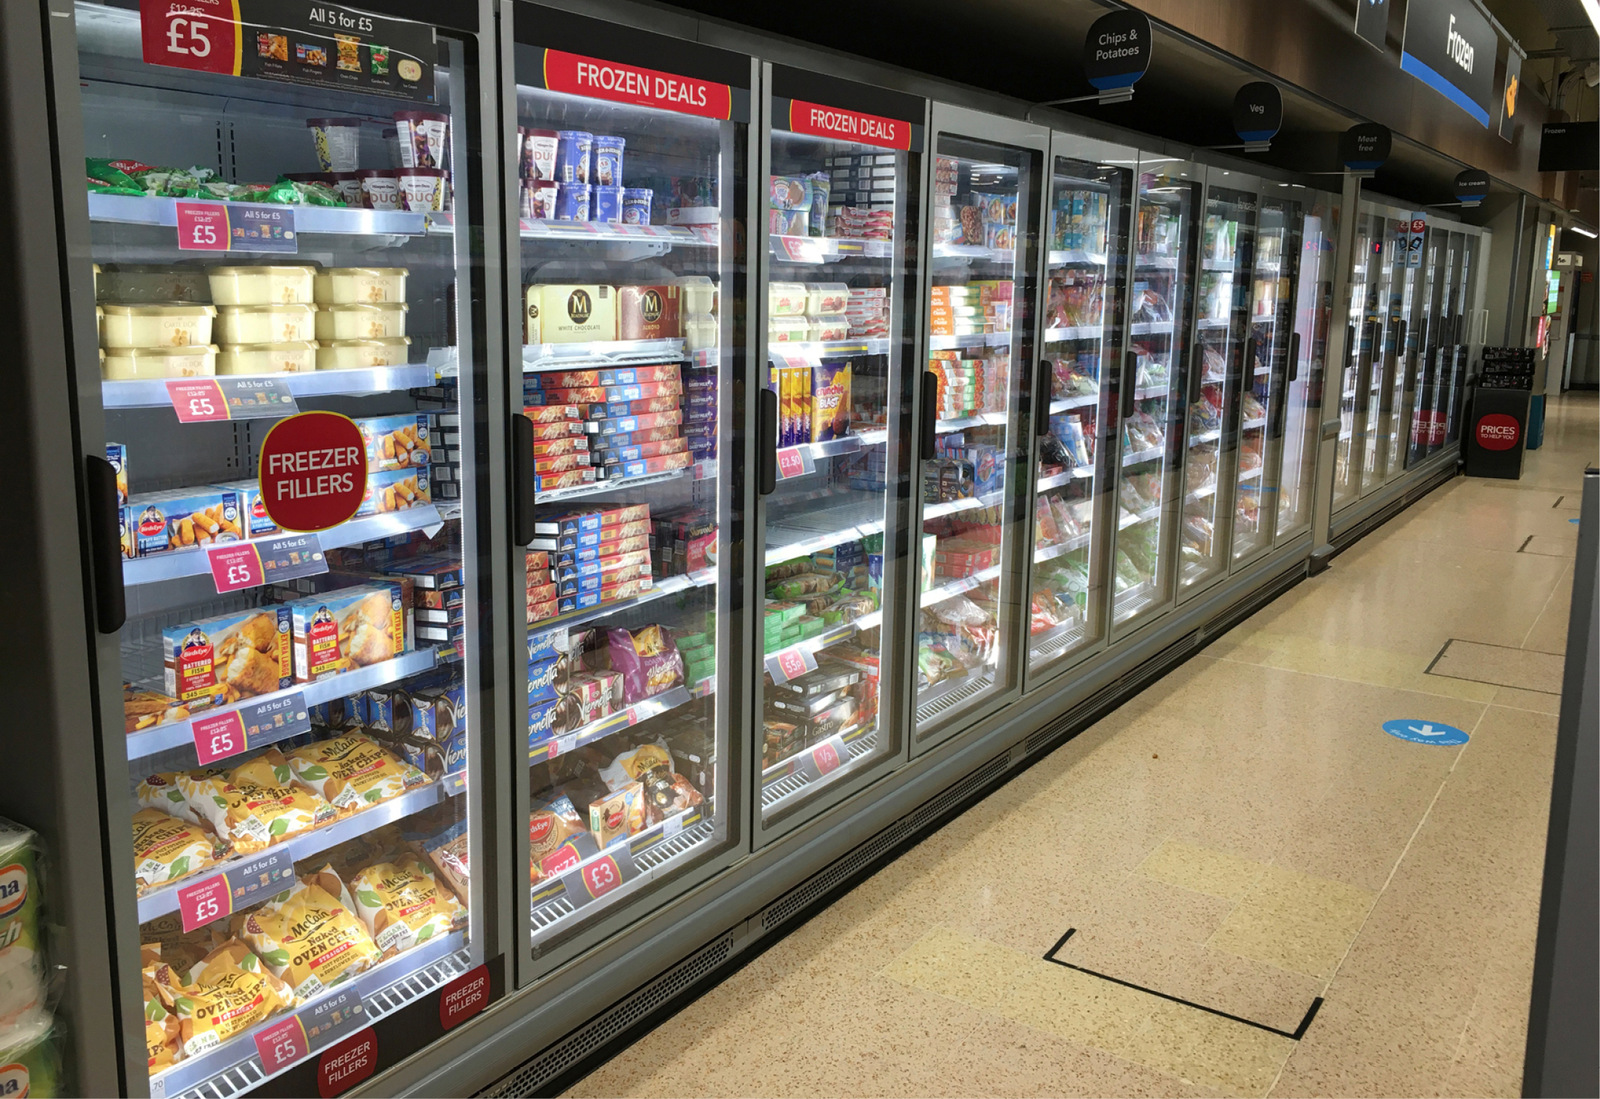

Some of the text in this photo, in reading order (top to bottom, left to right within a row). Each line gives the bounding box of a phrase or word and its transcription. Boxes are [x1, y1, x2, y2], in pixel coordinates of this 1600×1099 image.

[309, 8, 373, 32] All 5 for £5
[167, 18, 211, 57] £5
[1098, 29, 1138, 46] Chips &
[1446, 14, 1475, 75] Frozen
[1095, 46, 1139, 61] Potatoes
[577, 62, 707, 106] FROZEN DEALS
[1250, 103, 1264, 114] Veg
[810, 108, 895, 140] FROZEN DEALS
[1358, 136, 1377, 144] Meat
[1358, 144, 1374, 152] free
[370, 193, 398, 204] DUO
[406, 192, 434, 202] DUO
[244, 211, 281, 220] All 5 for £5
[192, 224, 217, 244] £5
[237, 381, 246, 389] All
[253, 380, 264, 388] for
[265, 379, 274, 387] £5
[816, 384, 845, 396] crunchie
[189, 398, 215, 416] £5
[820, 396, 839, 409] BLAST
[1481, 425, 1515, 435] PRICES
[269, 446, 360, 475] FREEZER
[781, 455, 801, 468] £2.50
[277, 472, 354, 501] FILLERS
[272, 542, 281, 550] All
[287, 540, 297, 548] for
[298, 538, 306, 547] £5
[227, 565, 250, 584] £5
[312, 634, 337, 644] BATTERED
[183, 658, 212, 669] BATTERED
[281, 633, 289, 677] EXTRA LARGE
[785, 661, 802, 673] 55p
[186, 691, 198, 699] 345
[576, 686, 613, 720] Viennetta
[257, 706, 266, 715] All
[272, 701, 282, 710] for
[283, 699, 292, 707] £5
[812, 721, 834, 736] Gastro
[210, 733, 233, 755] £5
[321, 735, 358, 758] McCain
[356, 749, 388, 768] CHIPS
[529, 821, 548, 833] dsEye
[243, 857, 278, 876] All 5 for £5
[591, 863, 614, 890] £3
[195, 897, 219, 922] £5
[291, 911, 330, 938] McCain
[307, 926, 339, 947] Naked
[293, 942, 328, 966] OVEN
[318, 944, 348, 963] STRAIGHT
[235, 978, 266, 1006] CHIPS
[445, 976, 484, 1006] FREEZER
[314, 994, 347, 1016] All 5 for £5
[448, 990, 482, 1016] FILLERS
[273, 1039, 297, 1064] £5
[324, 1040, 371, 1074] FREEZER
[328, 1056, 368, 1086] FILLERS
